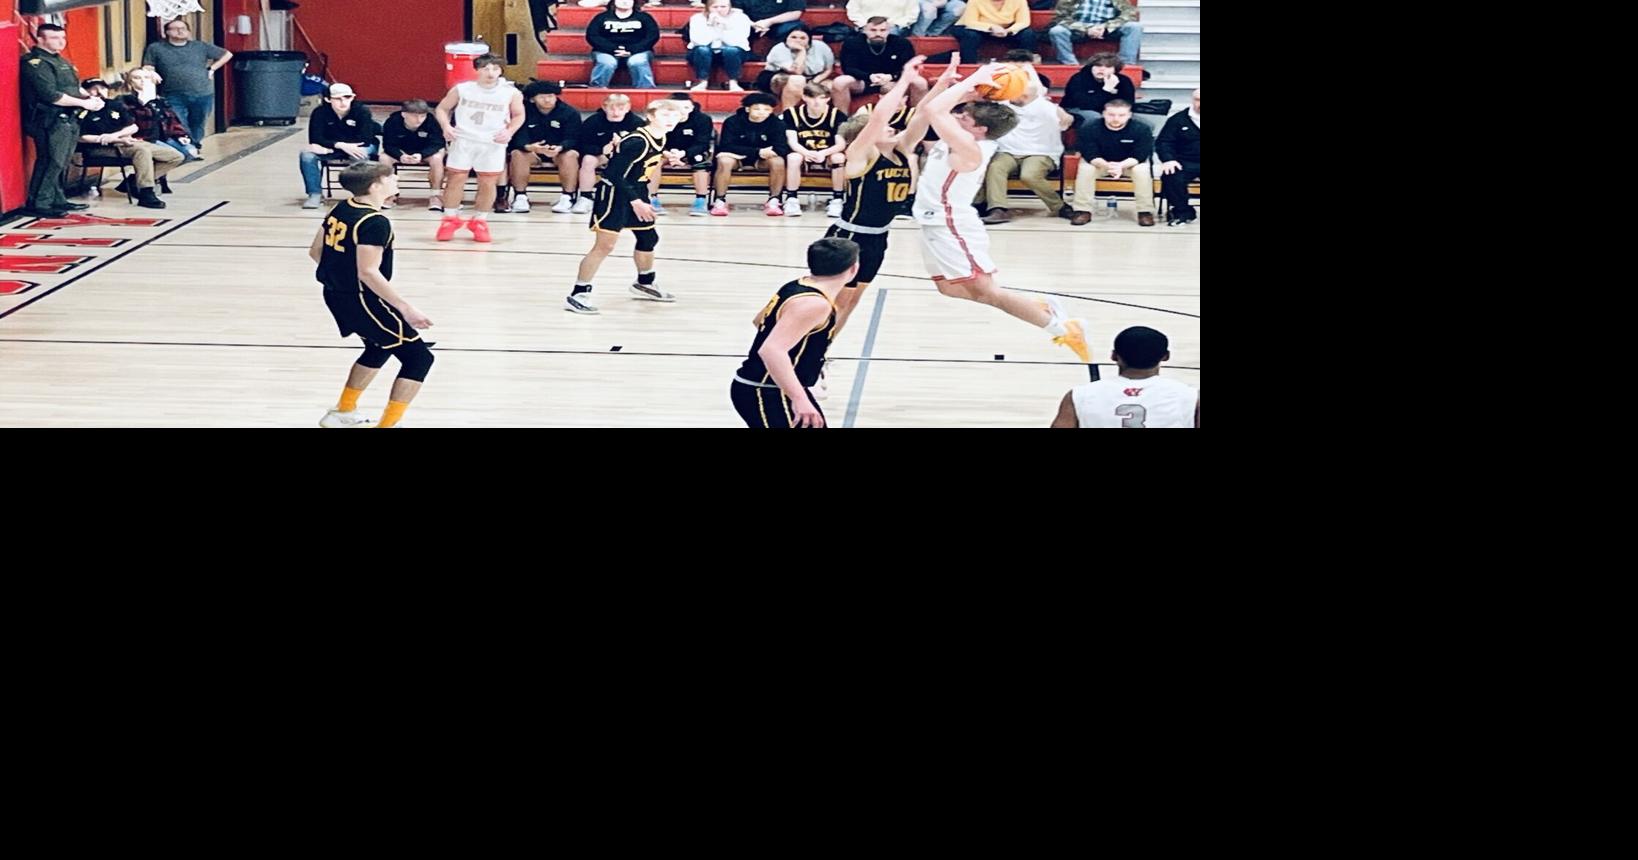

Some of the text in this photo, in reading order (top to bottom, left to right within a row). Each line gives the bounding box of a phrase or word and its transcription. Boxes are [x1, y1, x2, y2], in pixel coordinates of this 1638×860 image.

[470, 111, 485, 125] 4
[887, 182, 910, 202] 10
[325, 215, 348, 253] 32
[1115, 403, 1147, 428] 3
